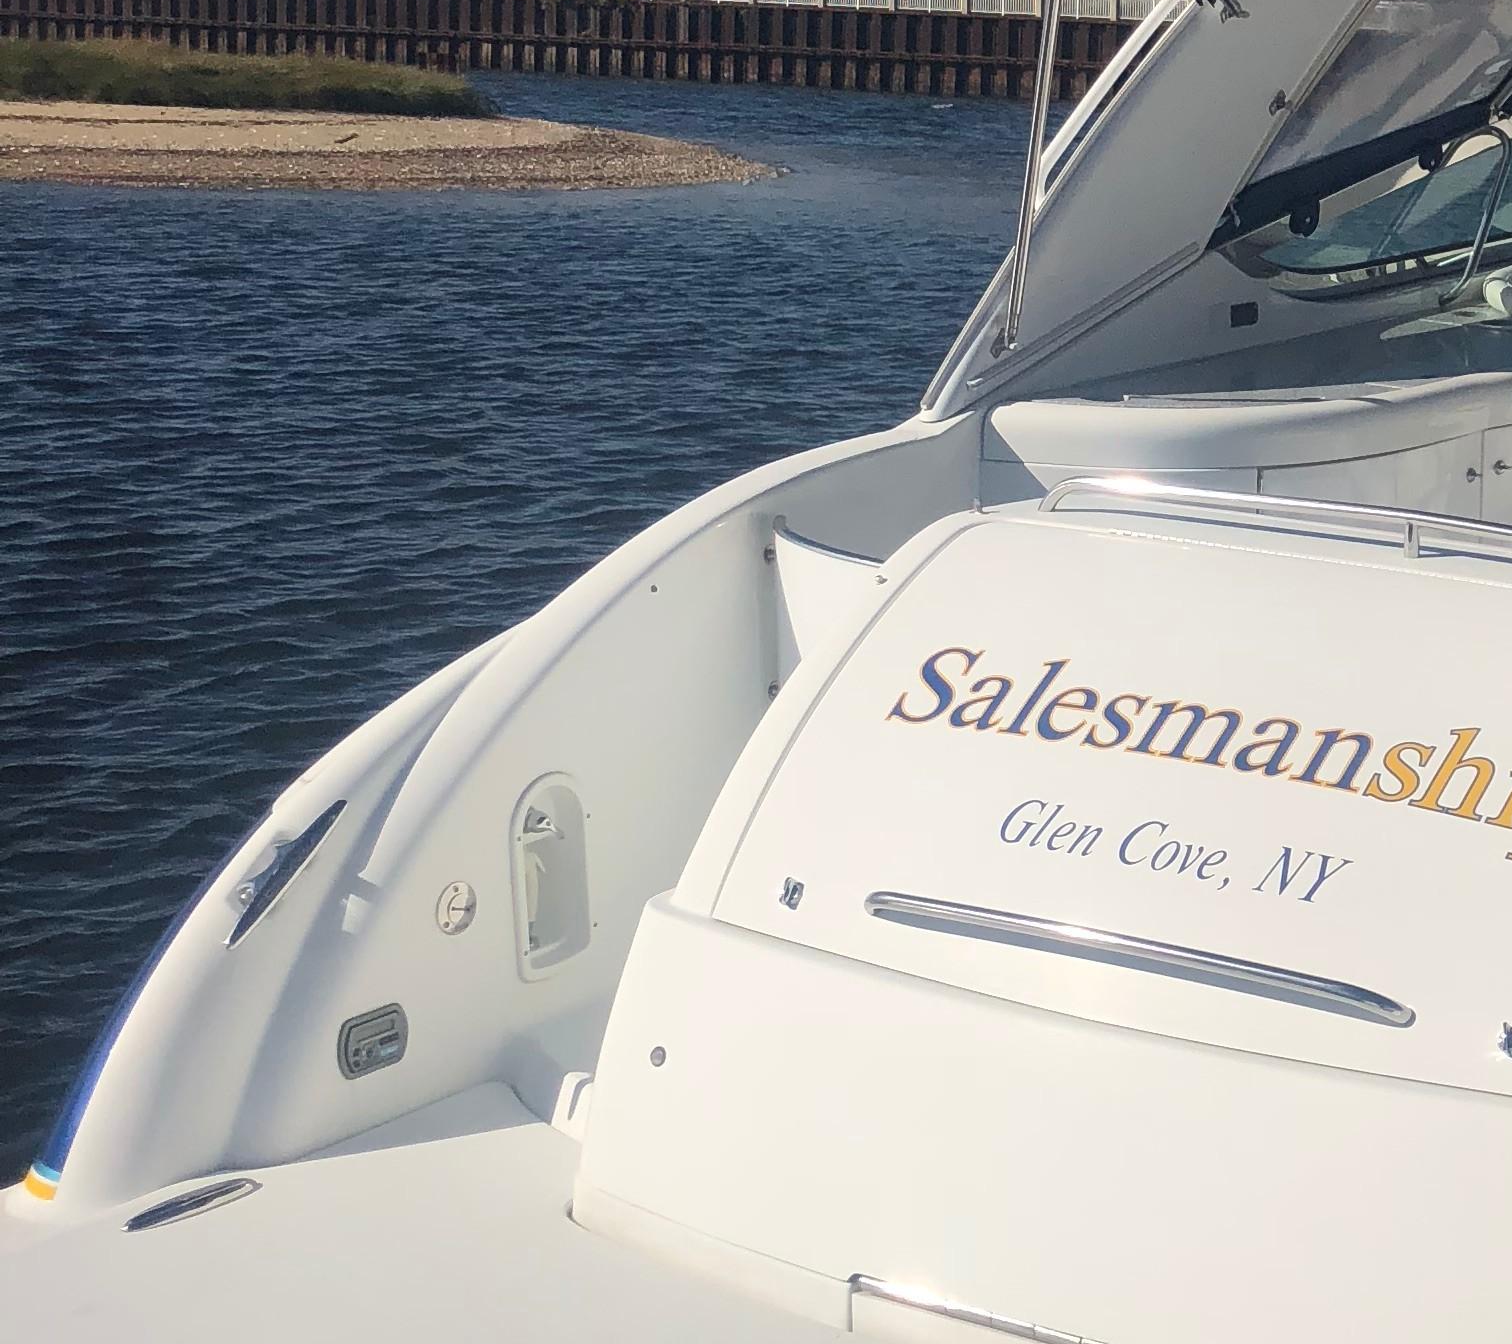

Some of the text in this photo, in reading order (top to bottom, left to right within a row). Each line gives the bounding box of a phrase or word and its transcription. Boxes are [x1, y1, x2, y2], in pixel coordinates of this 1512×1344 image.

[999, 799, 1354, 905] Glen Cove, NY
